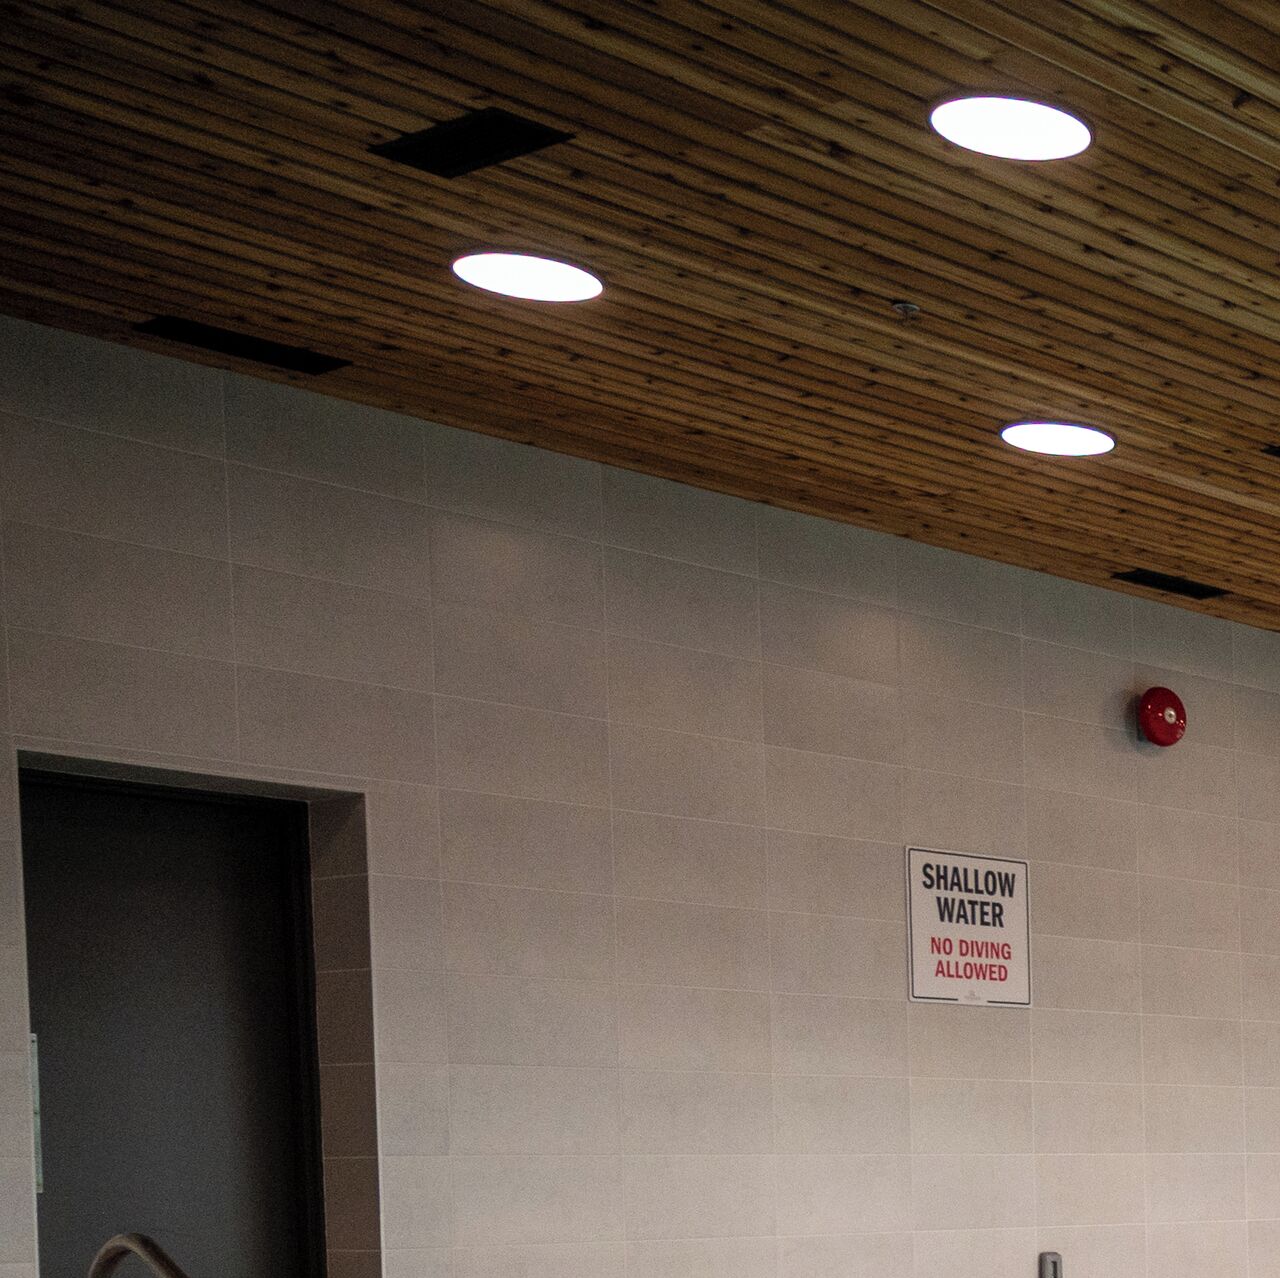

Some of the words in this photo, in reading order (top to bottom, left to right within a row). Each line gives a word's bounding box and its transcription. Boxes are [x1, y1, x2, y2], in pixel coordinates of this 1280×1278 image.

[922, 863, 1016, 898] SHALLOW
[936, 896, 1004, 928] WATER
[931, 937, 953, 955] NO
[959, 939, 1012, 960] DIVING
[935, 960, 1008, 982] ALLOWED
